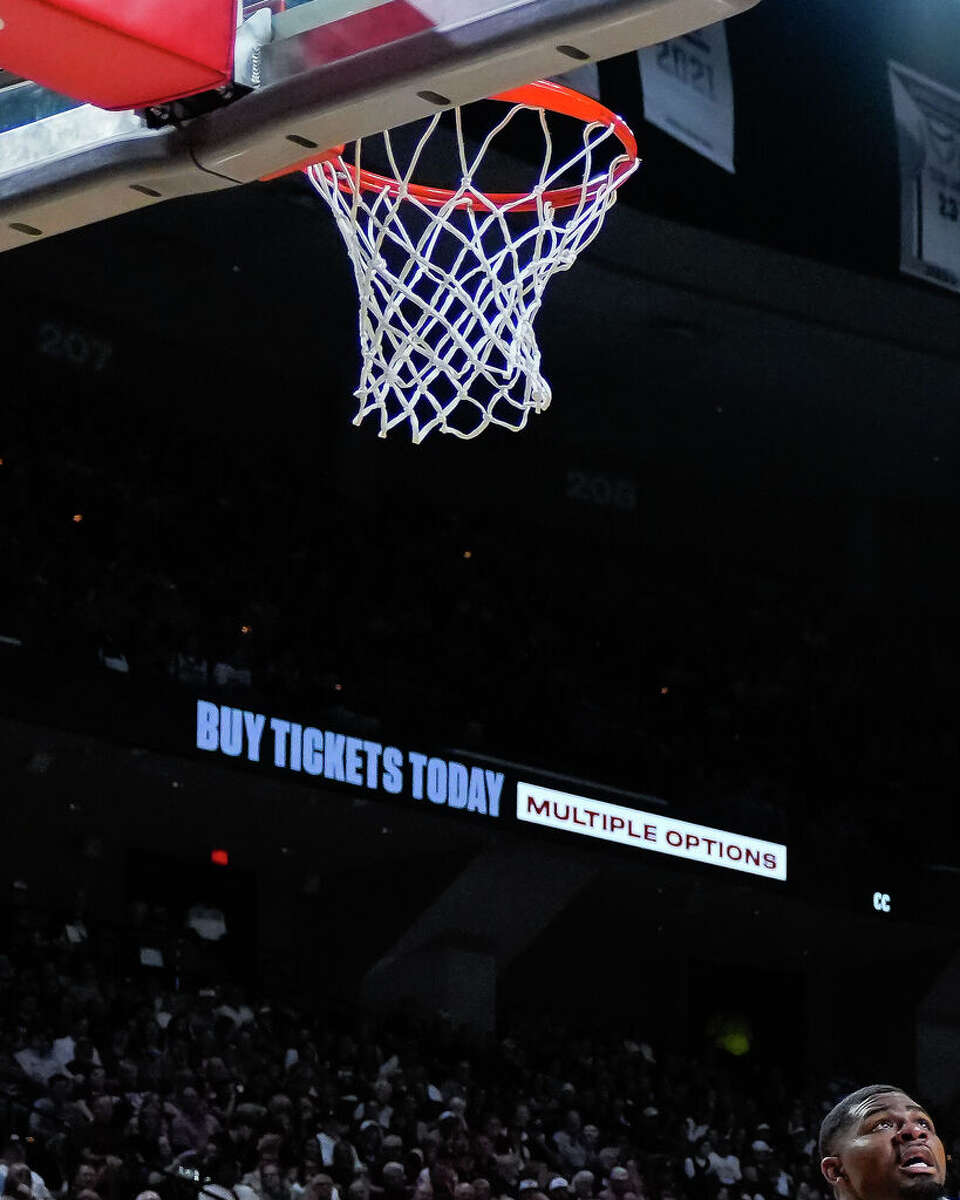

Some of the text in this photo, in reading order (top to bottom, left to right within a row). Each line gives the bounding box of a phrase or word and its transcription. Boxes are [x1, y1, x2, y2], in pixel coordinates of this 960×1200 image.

[197, 700, 505, 818] BUY TICKETS TODAY
[527, 796, 778, 870] MULTIPLE OPTIONS
[872, 891, 891, 912] CC
